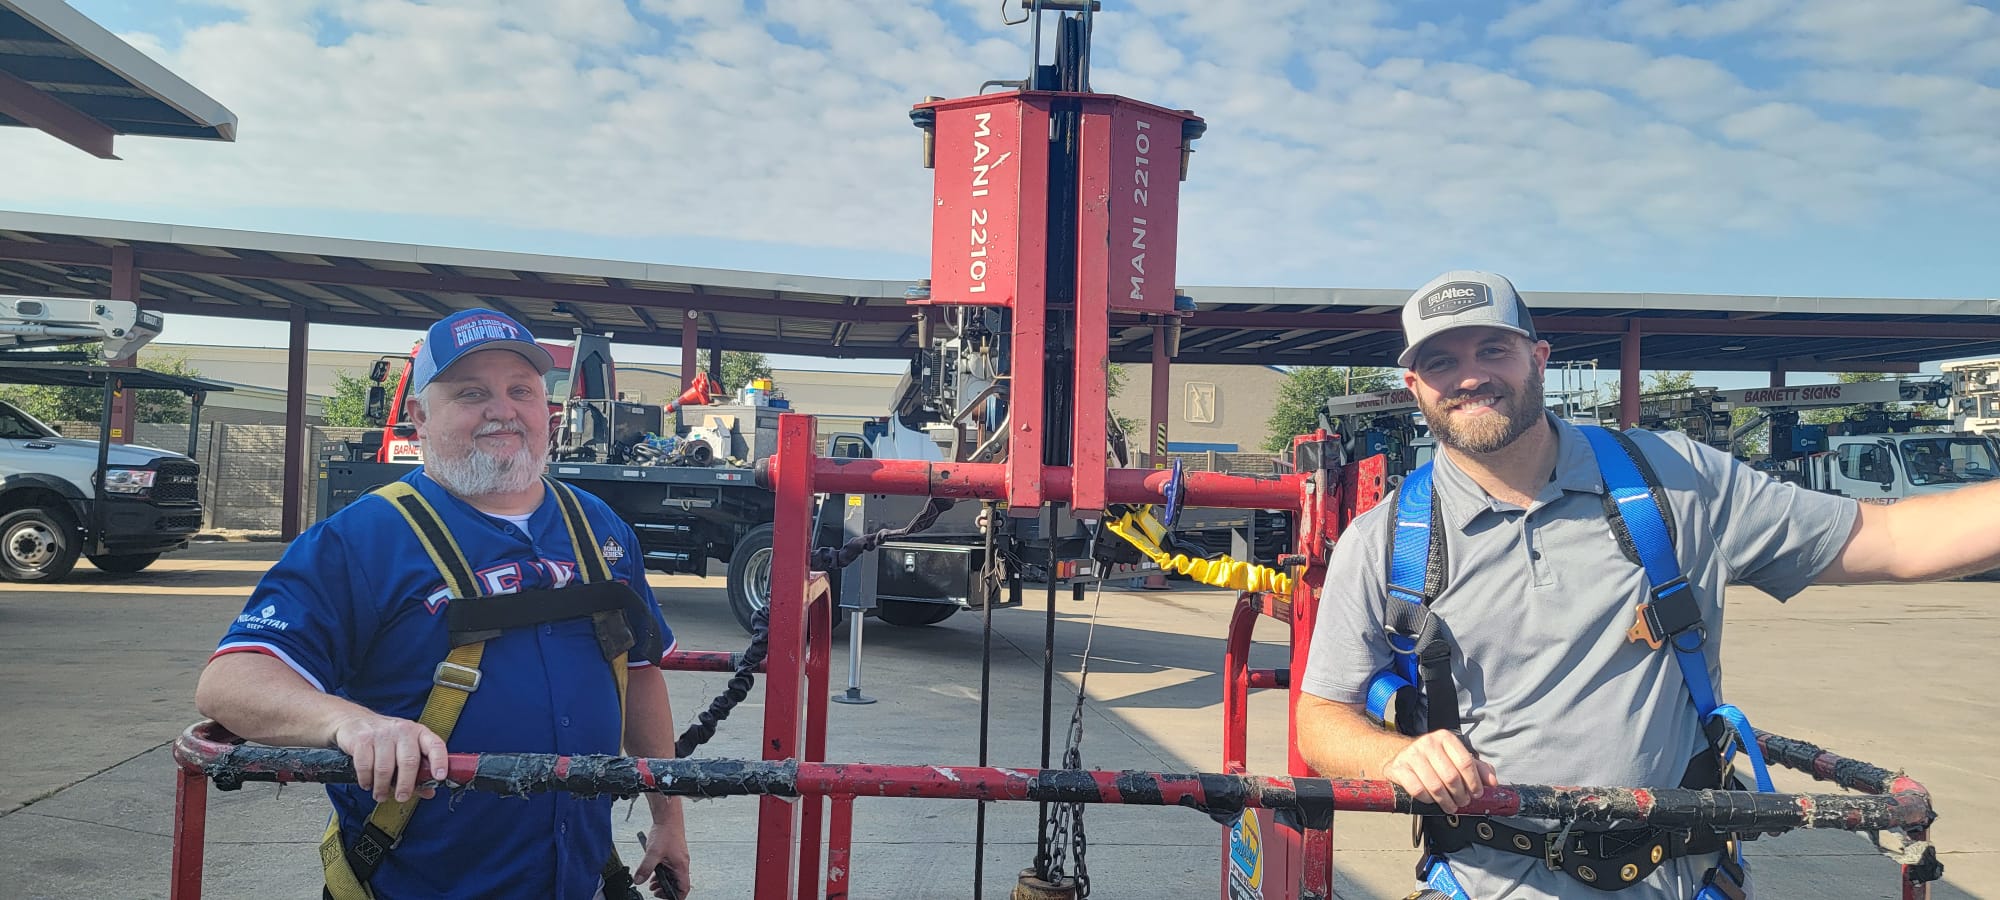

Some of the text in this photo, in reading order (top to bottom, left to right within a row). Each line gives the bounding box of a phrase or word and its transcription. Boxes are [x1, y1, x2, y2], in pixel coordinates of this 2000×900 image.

[969, 112, 991, 293] MANI 22101
[1130, 120, 1150, 300] MANI 22101
[1440, 287, 1475, 302] Altec
[455, 321, 477, 332] WORLD
[456, 325, 506, 346] CHAMPIONS
[1744, 386, 1841, 403] BARNETT SIGNS
